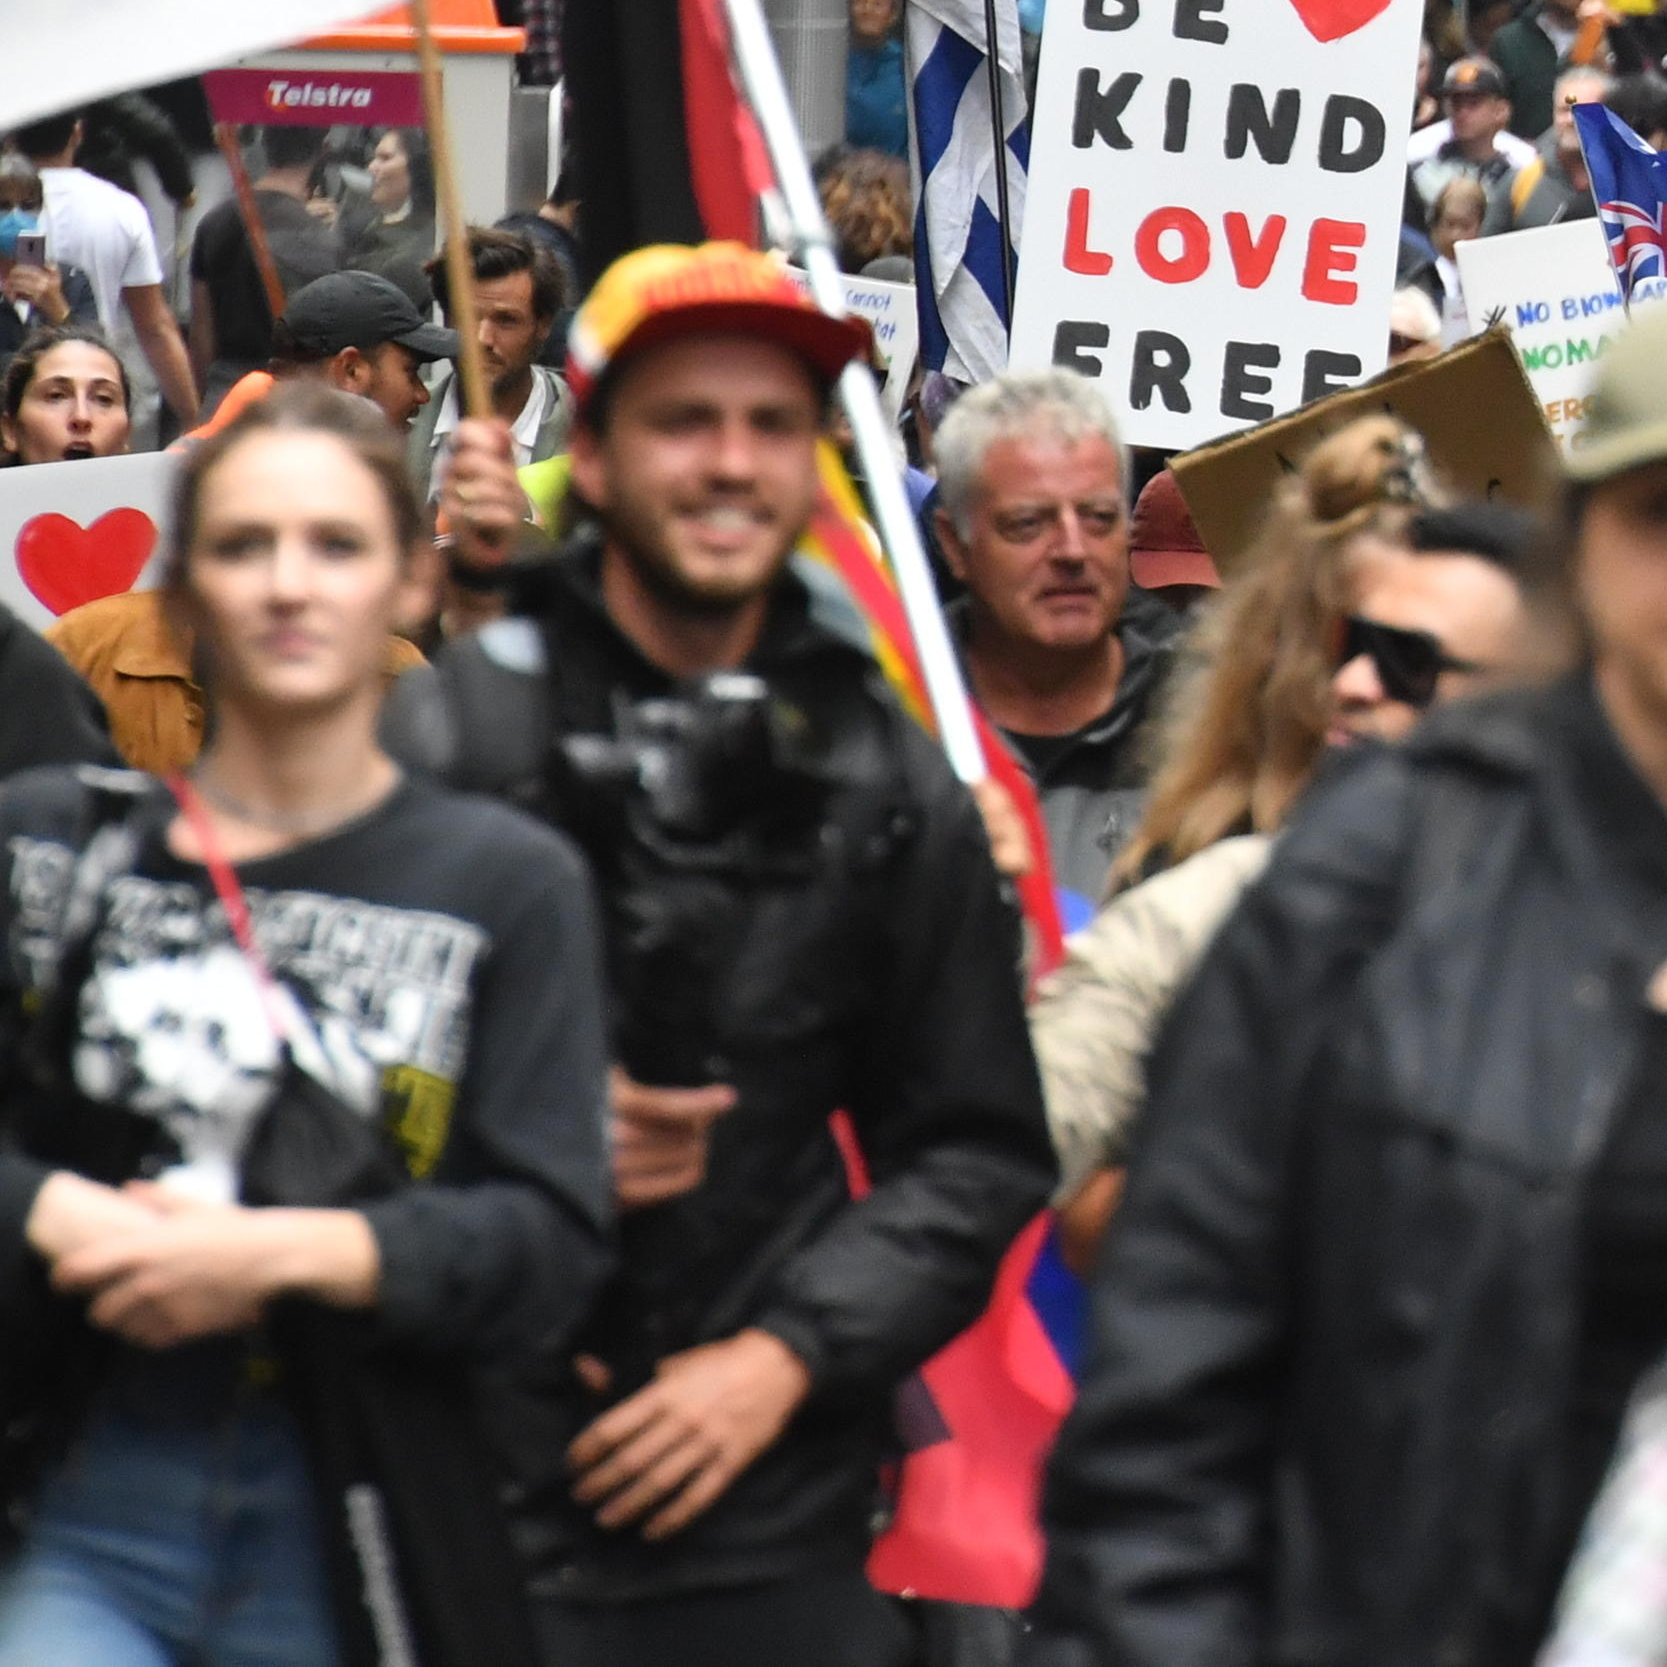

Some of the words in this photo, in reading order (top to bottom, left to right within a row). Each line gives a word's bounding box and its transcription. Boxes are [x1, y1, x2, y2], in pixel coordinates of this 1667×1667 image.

[269, 79, 372, 109] Telstra
[1071, 66, 1386, 174] KIND
[1062, 187, 1367, 306] LOVE
[1515, 300, 1550, 329] NO
[1051, 319, 1363, 422] FREE
